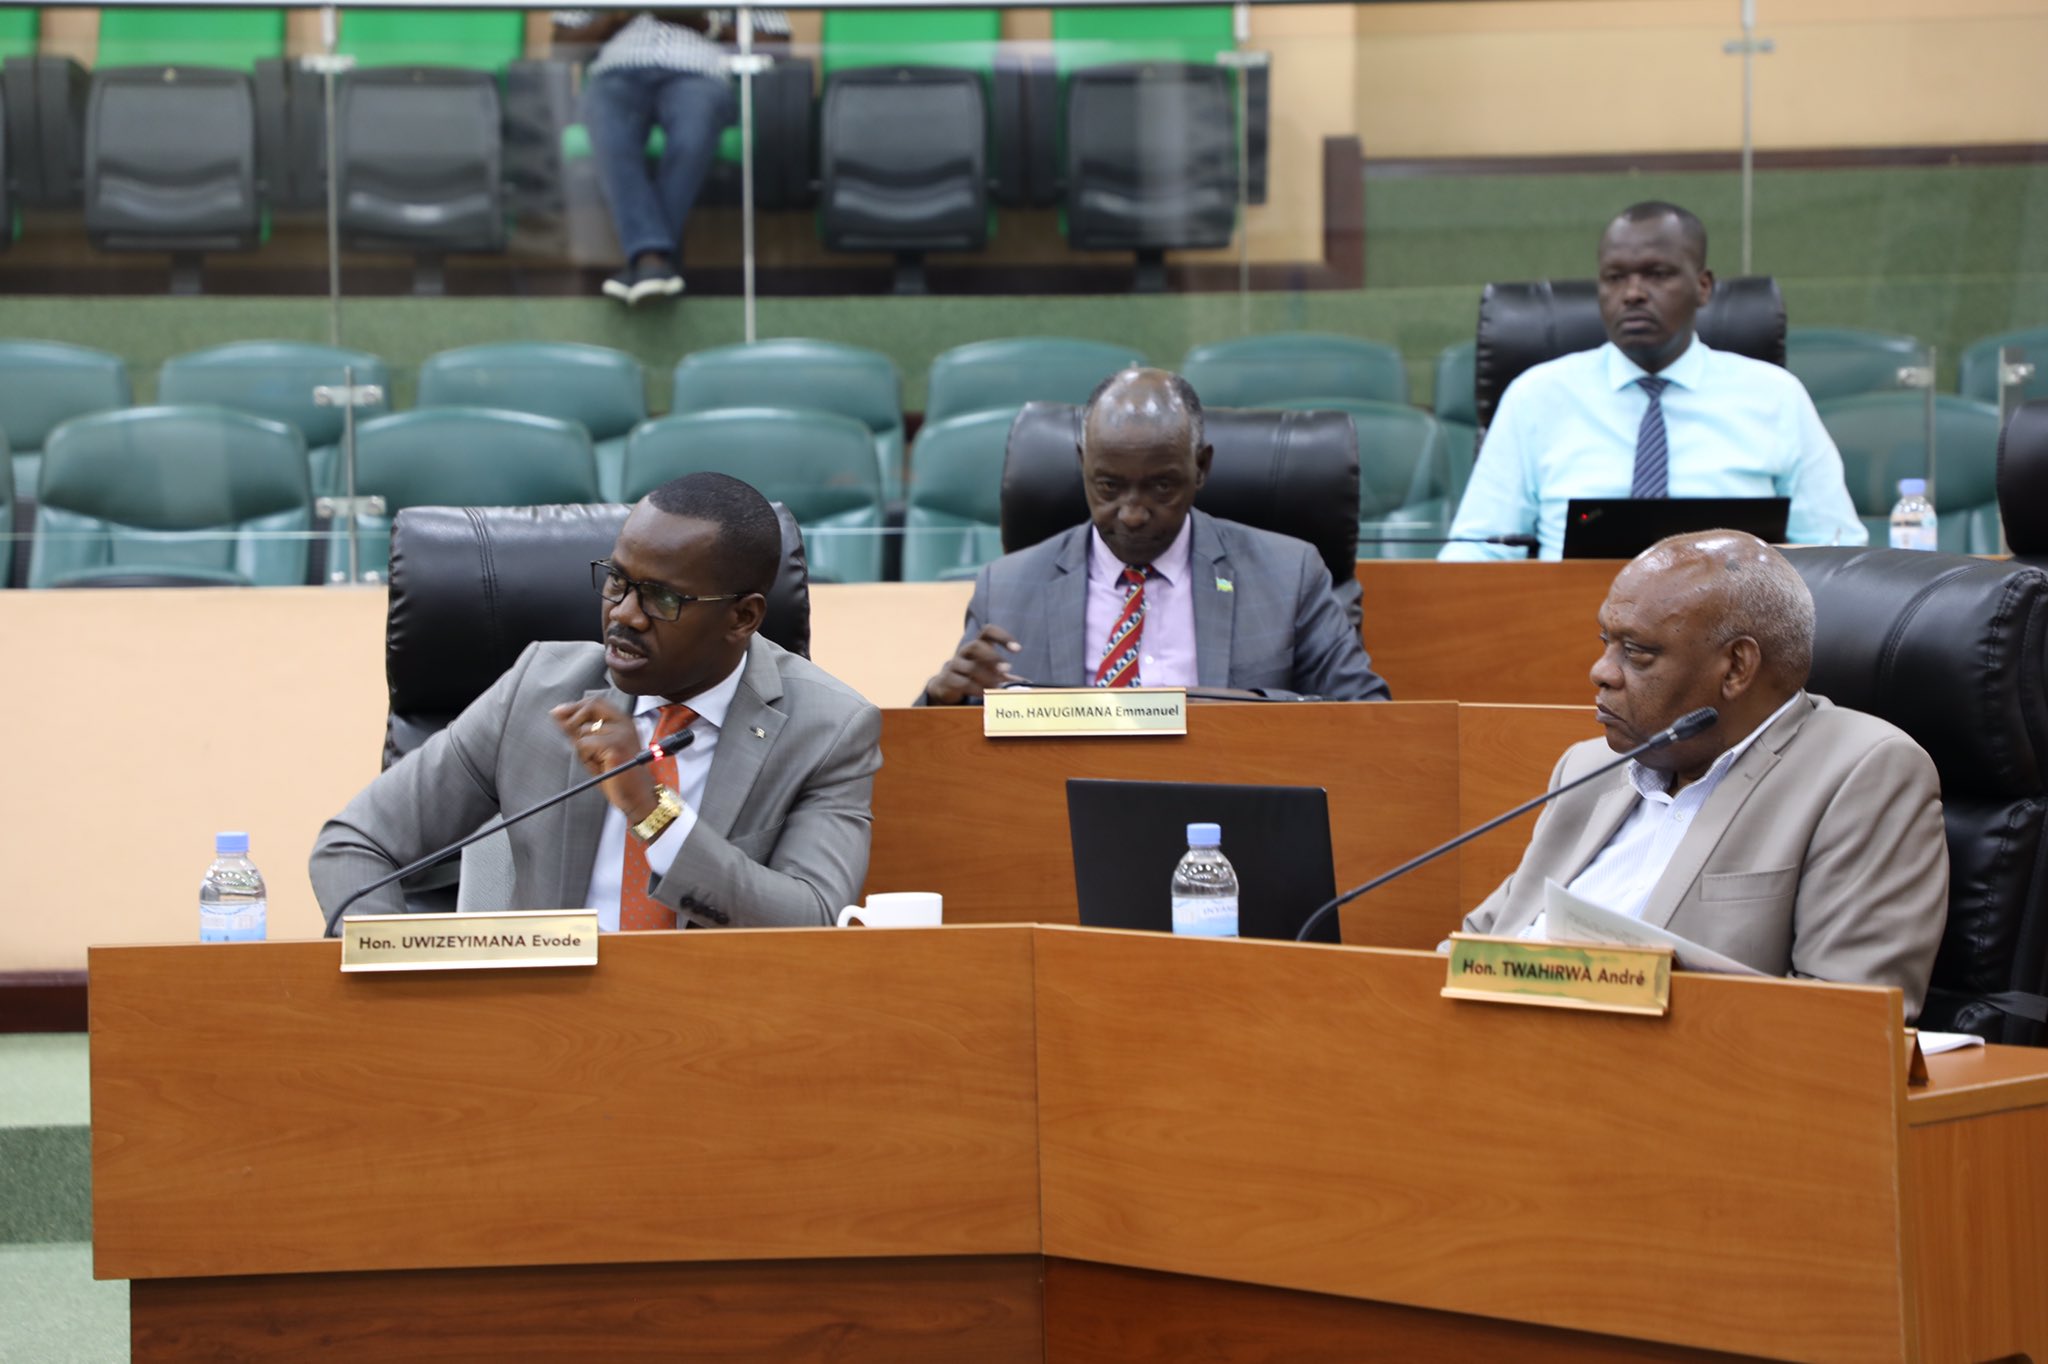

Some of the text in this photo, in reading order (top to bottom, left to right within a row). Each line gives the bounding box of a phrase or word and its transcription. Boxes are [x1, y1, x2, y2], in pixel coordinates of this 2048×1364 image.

[995, 705, 1180, 719] Hon. HAVUGIMANA Emmanuel
[359, 934, 582, 950] Hon. UWIZEYIMANA Evode
[1462, 959, 1645, 986] Hon. TWAHIRWA André
